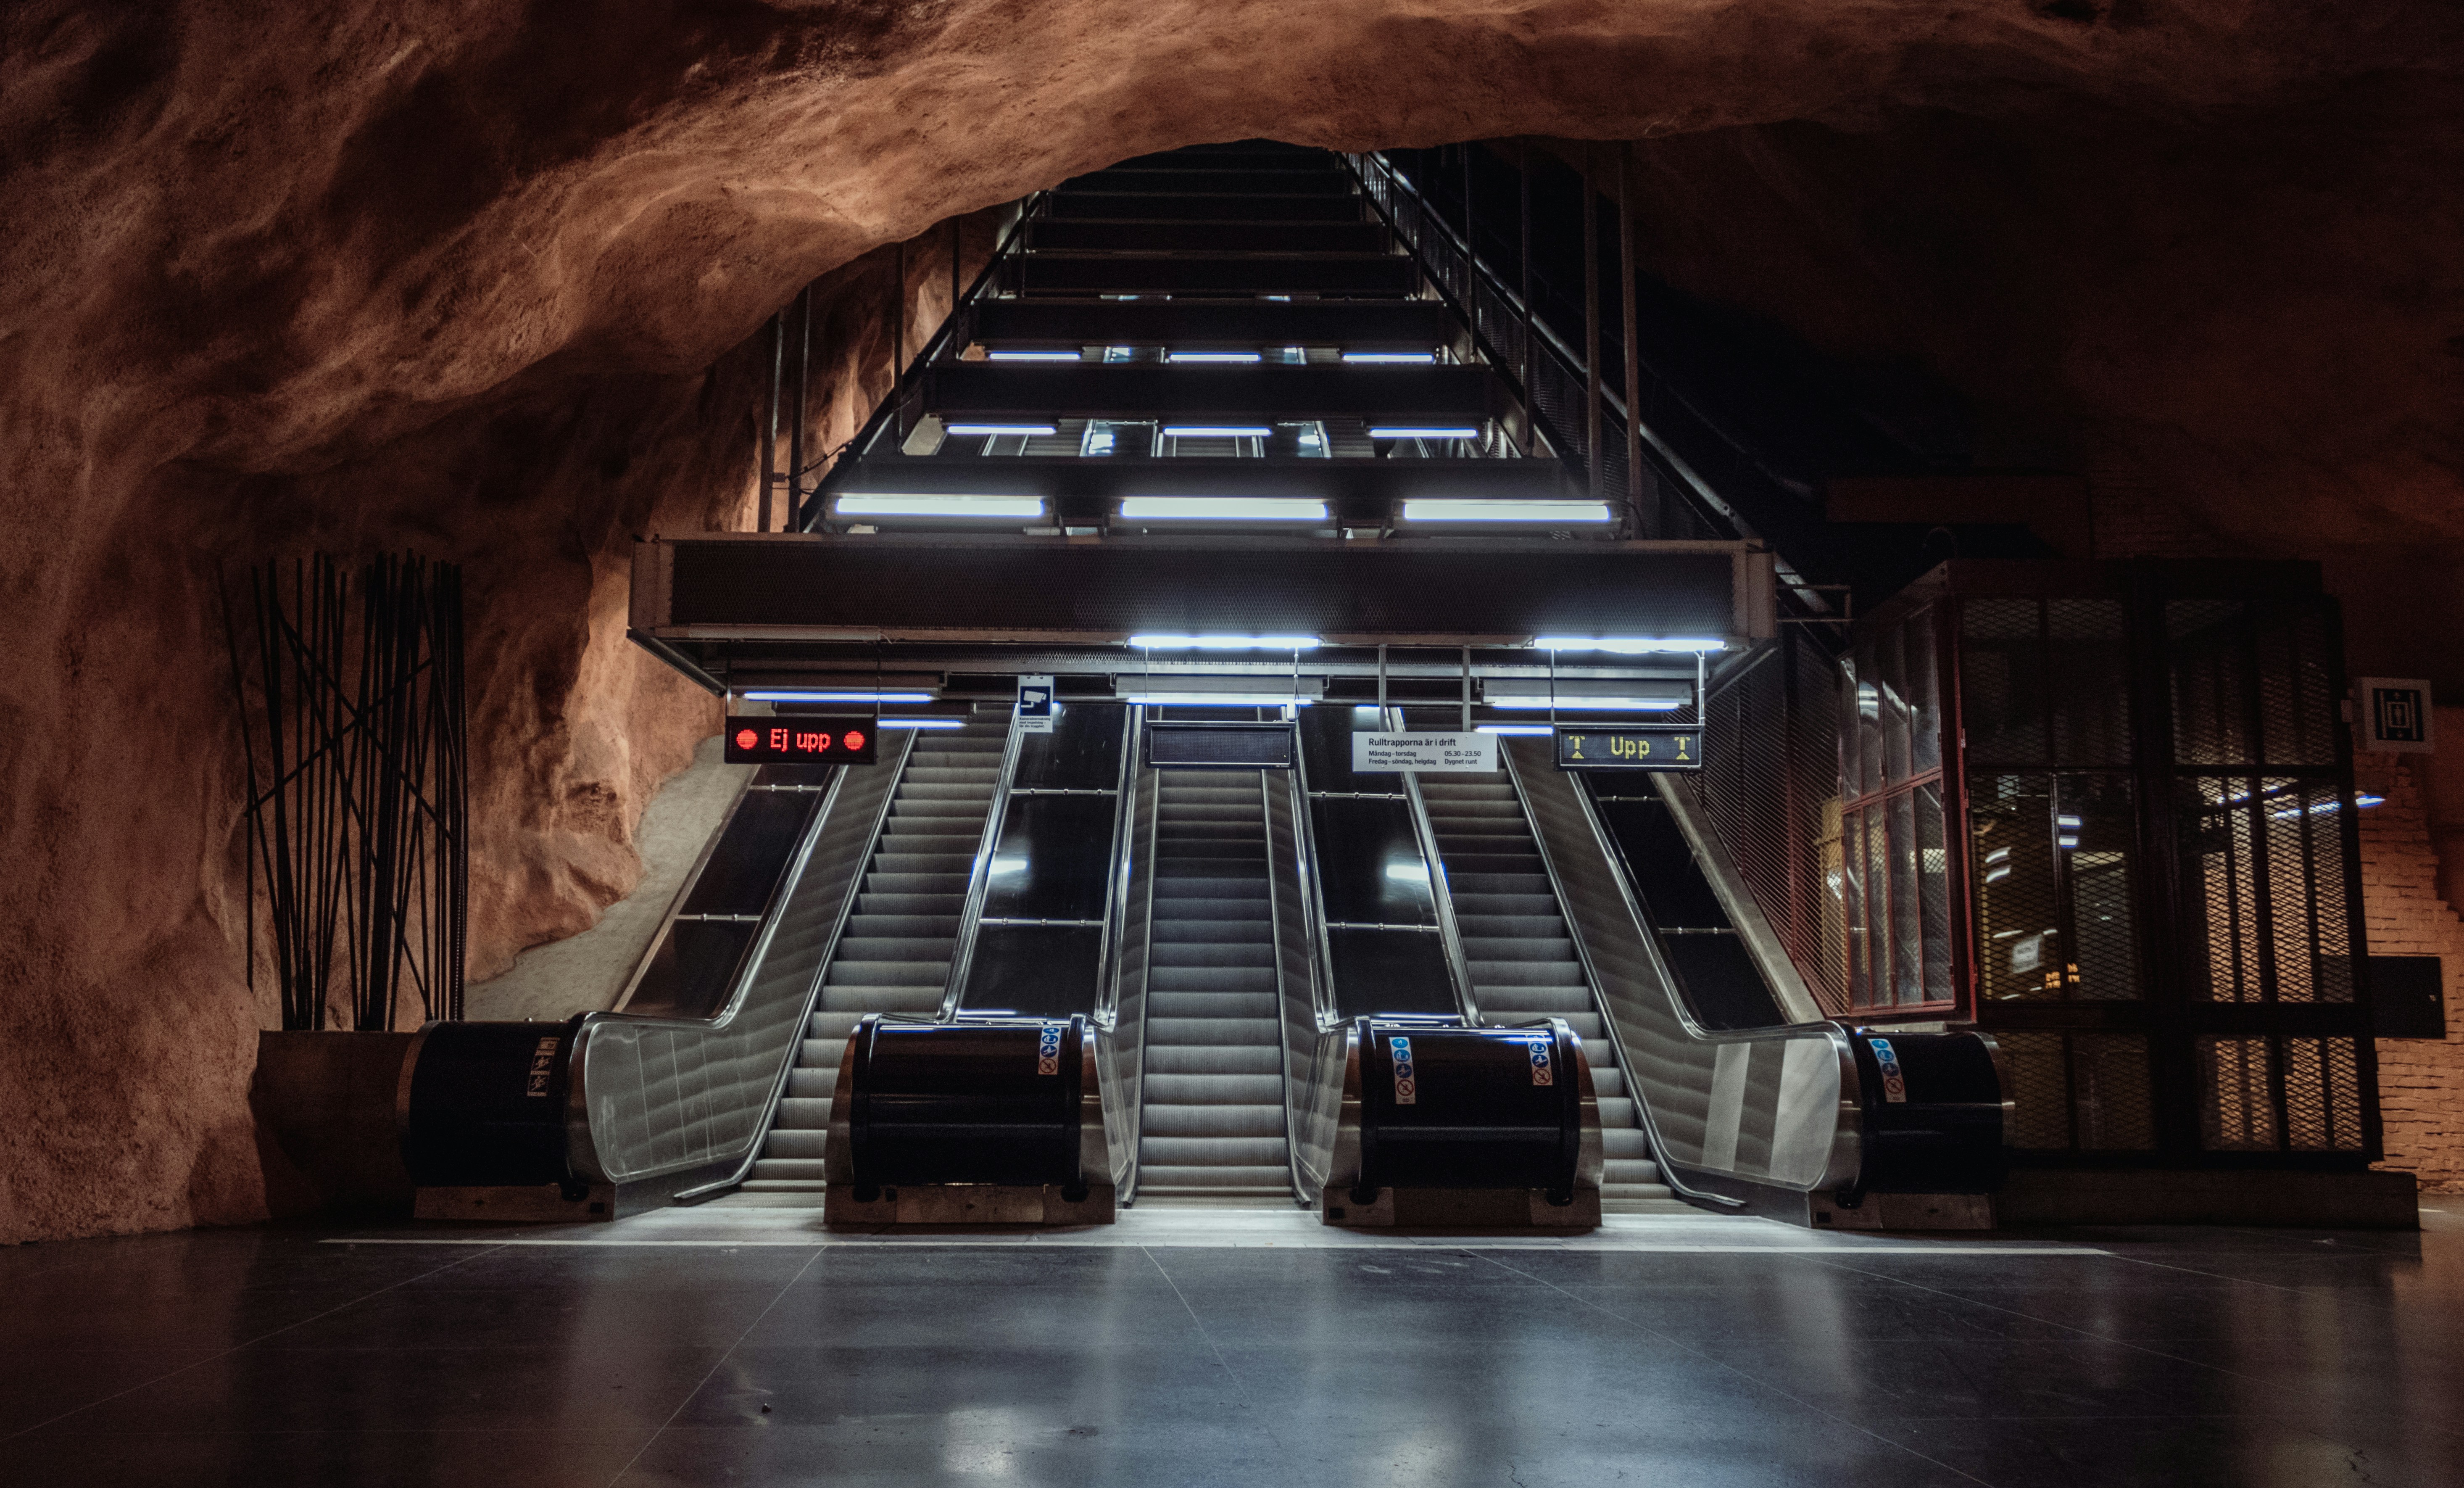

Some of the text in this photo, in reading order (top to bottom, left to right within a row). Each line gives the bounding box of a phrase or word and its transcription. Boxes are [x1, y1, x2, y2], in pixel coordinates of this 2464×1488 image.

[770, 729, 831, 752] Ej upp
[1368, 738, 1423, 747] Rulltrapporna
[1610, 736, 1650, 759] Upp
